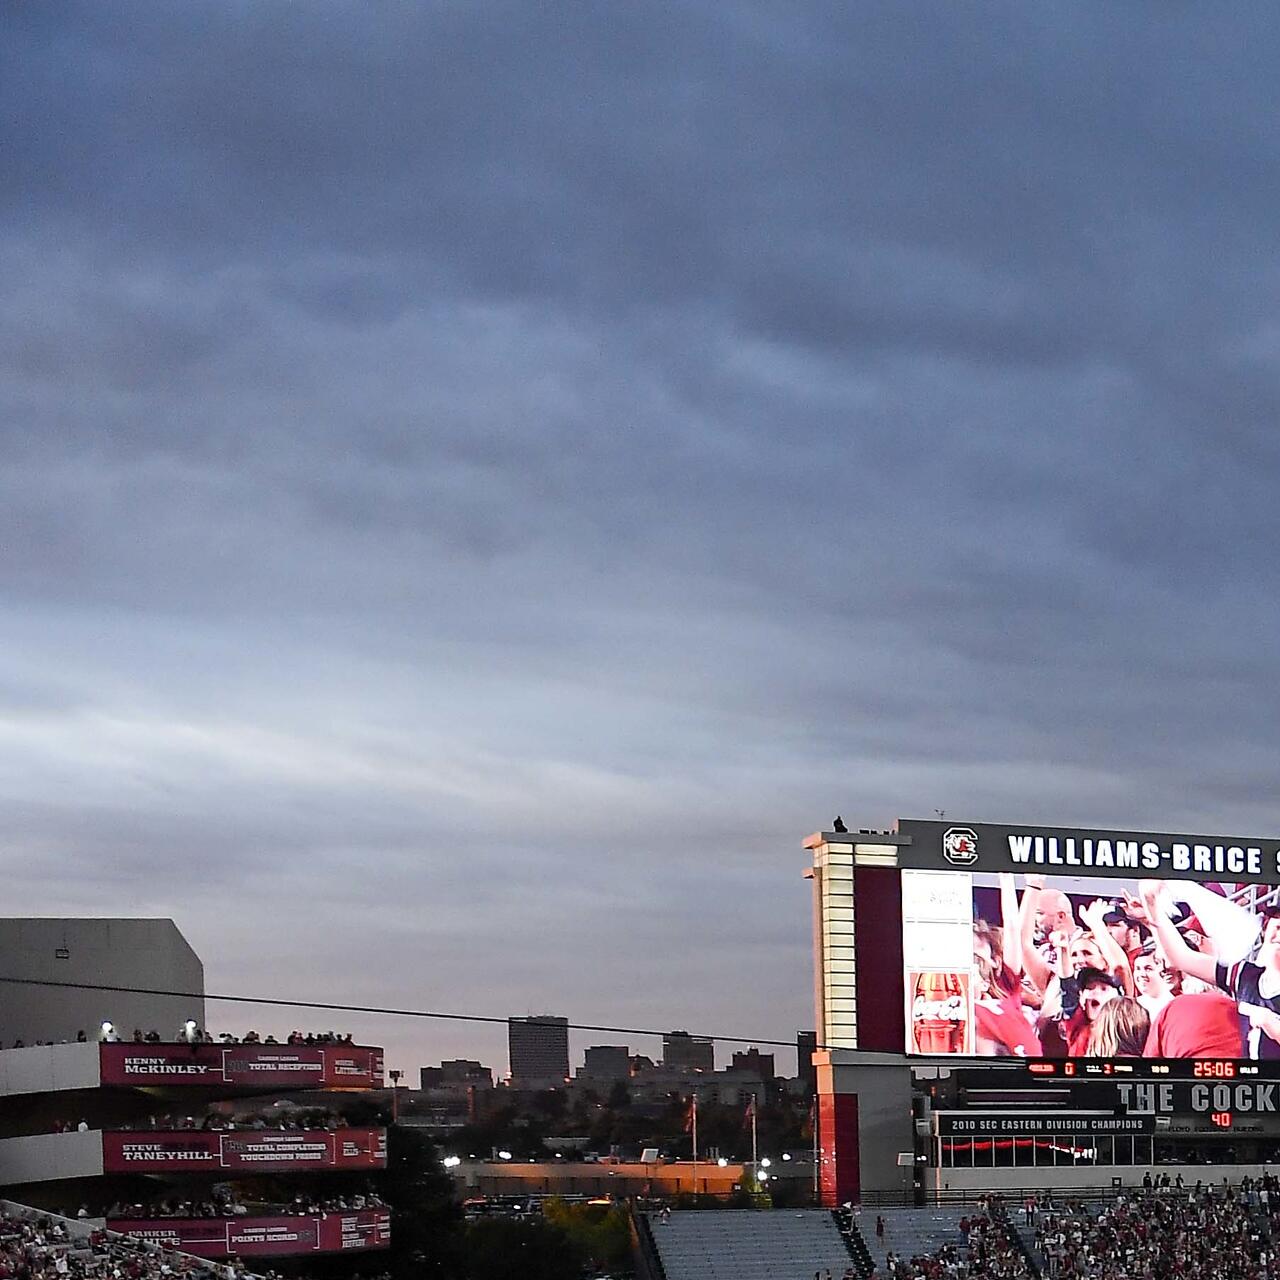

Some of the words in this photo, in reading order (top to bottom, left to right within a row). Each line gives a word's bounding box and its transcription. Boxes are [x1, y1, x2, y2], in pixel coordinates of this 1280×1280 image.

[1007, 835, 1261, 874] WILLIAMS-BRICE
[125, 1065, 207, 1074] McKINLEY
[249, 1063, 276, 1071] TOTAL
[1194, 1062, 1234, 1077] 25:06
[1117, 1084, 1174, 1115] THE
[952, 1120, 975, 1130] 2010
[979, 1120, 997, 1129] SEC
[1001, 1120, 1042, 1129] EASTERN
[1046, 1120, 1087, 1129] DIVISION
[1091, 1120, 1143, 1129] CHAMPIONS
[1212, 1113, 1230, 1127] 40
[122, 1152, 213, 1160] TANEYHILL
[128, 1230, 177, 1238] PARKER
[231, 1234, 265, 1243] POINTS
[267, 1233, 298, 1242] SCORED
